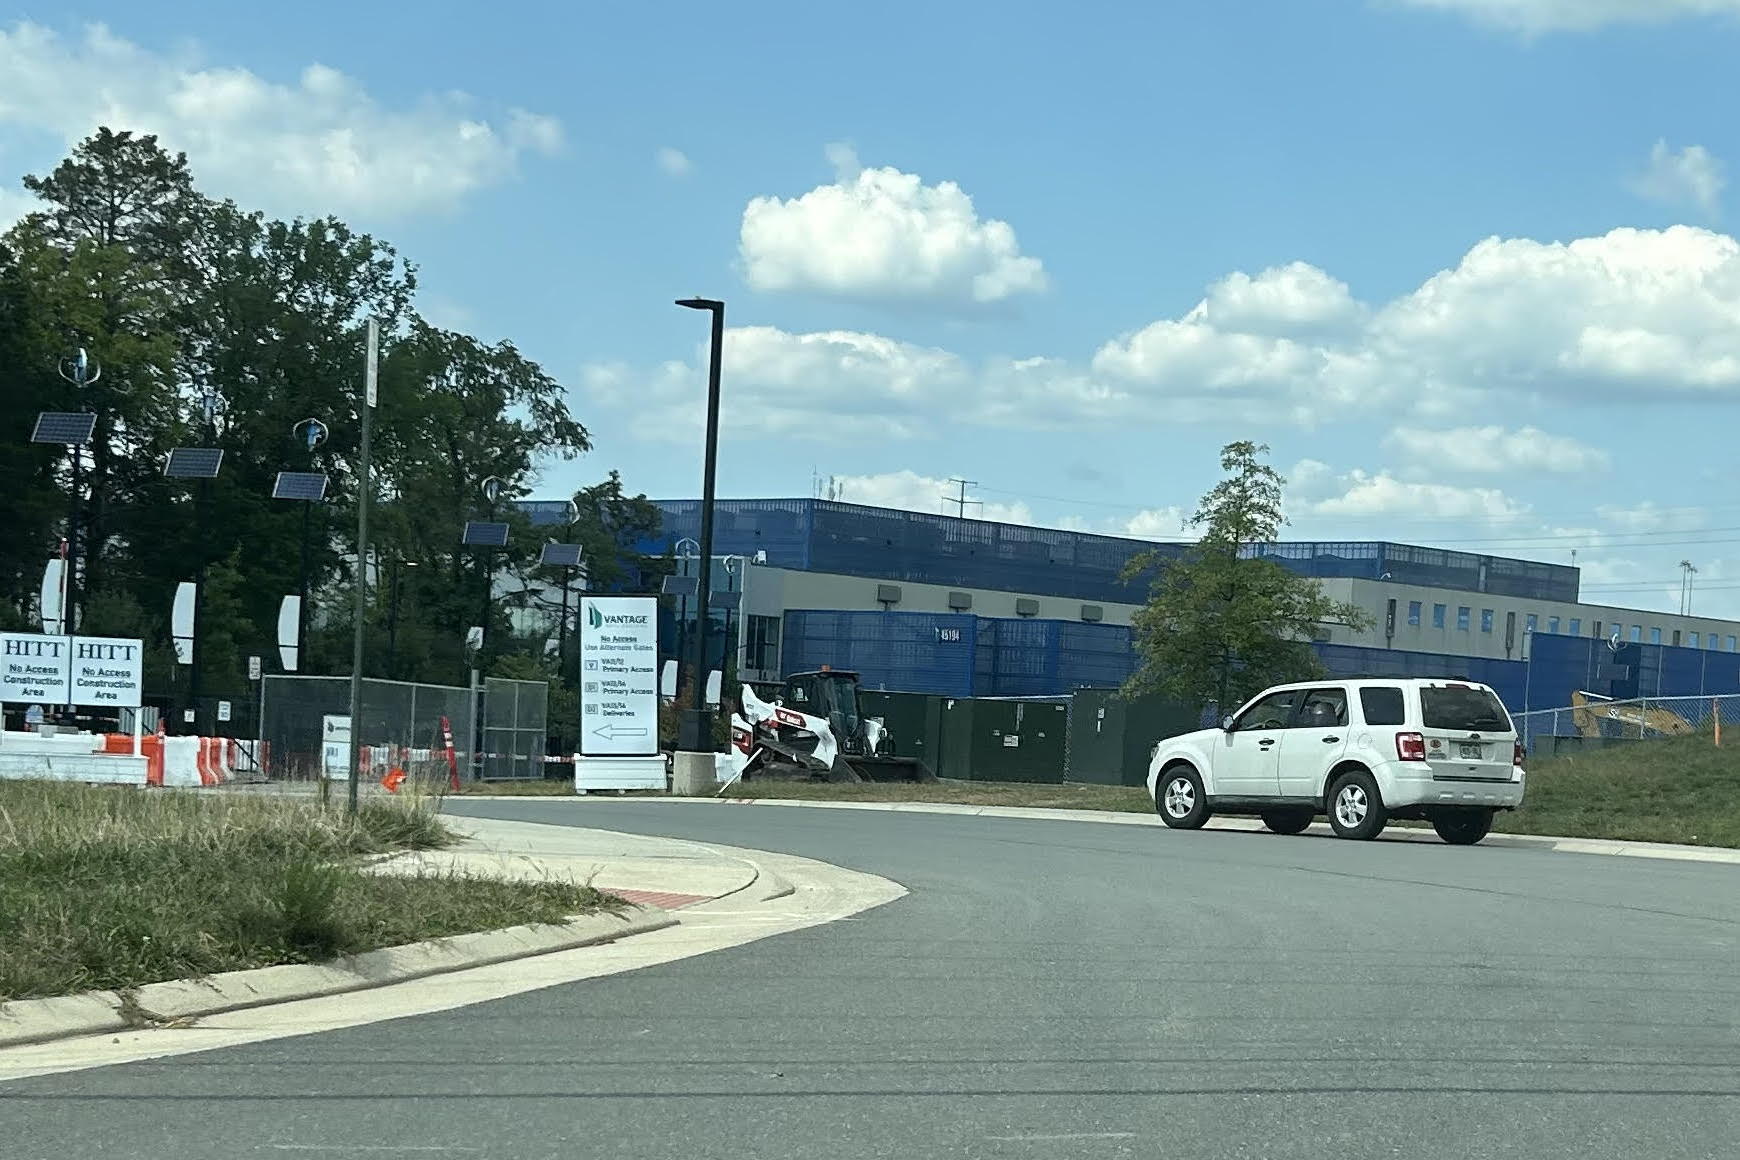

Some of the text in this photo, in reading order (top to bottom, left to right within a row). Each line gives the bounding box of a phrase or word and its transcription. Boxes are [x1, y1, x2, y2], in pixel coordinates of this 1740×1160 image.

[604, 615, 648, 624] VANTAGE
[612, 635, 638, 643] Access
[4, 639, 65, 657] HITT
[78, 643, 137, 660] HITT
[9, 663, 59, 674] No Access
[82, 666, 131, 678] No Access
[3, 674, 64, 687] Construction
[76, 678, 136, 689] Construction
[21, 687, 45, 697] Area
[94, 690, 118, 700] Area
